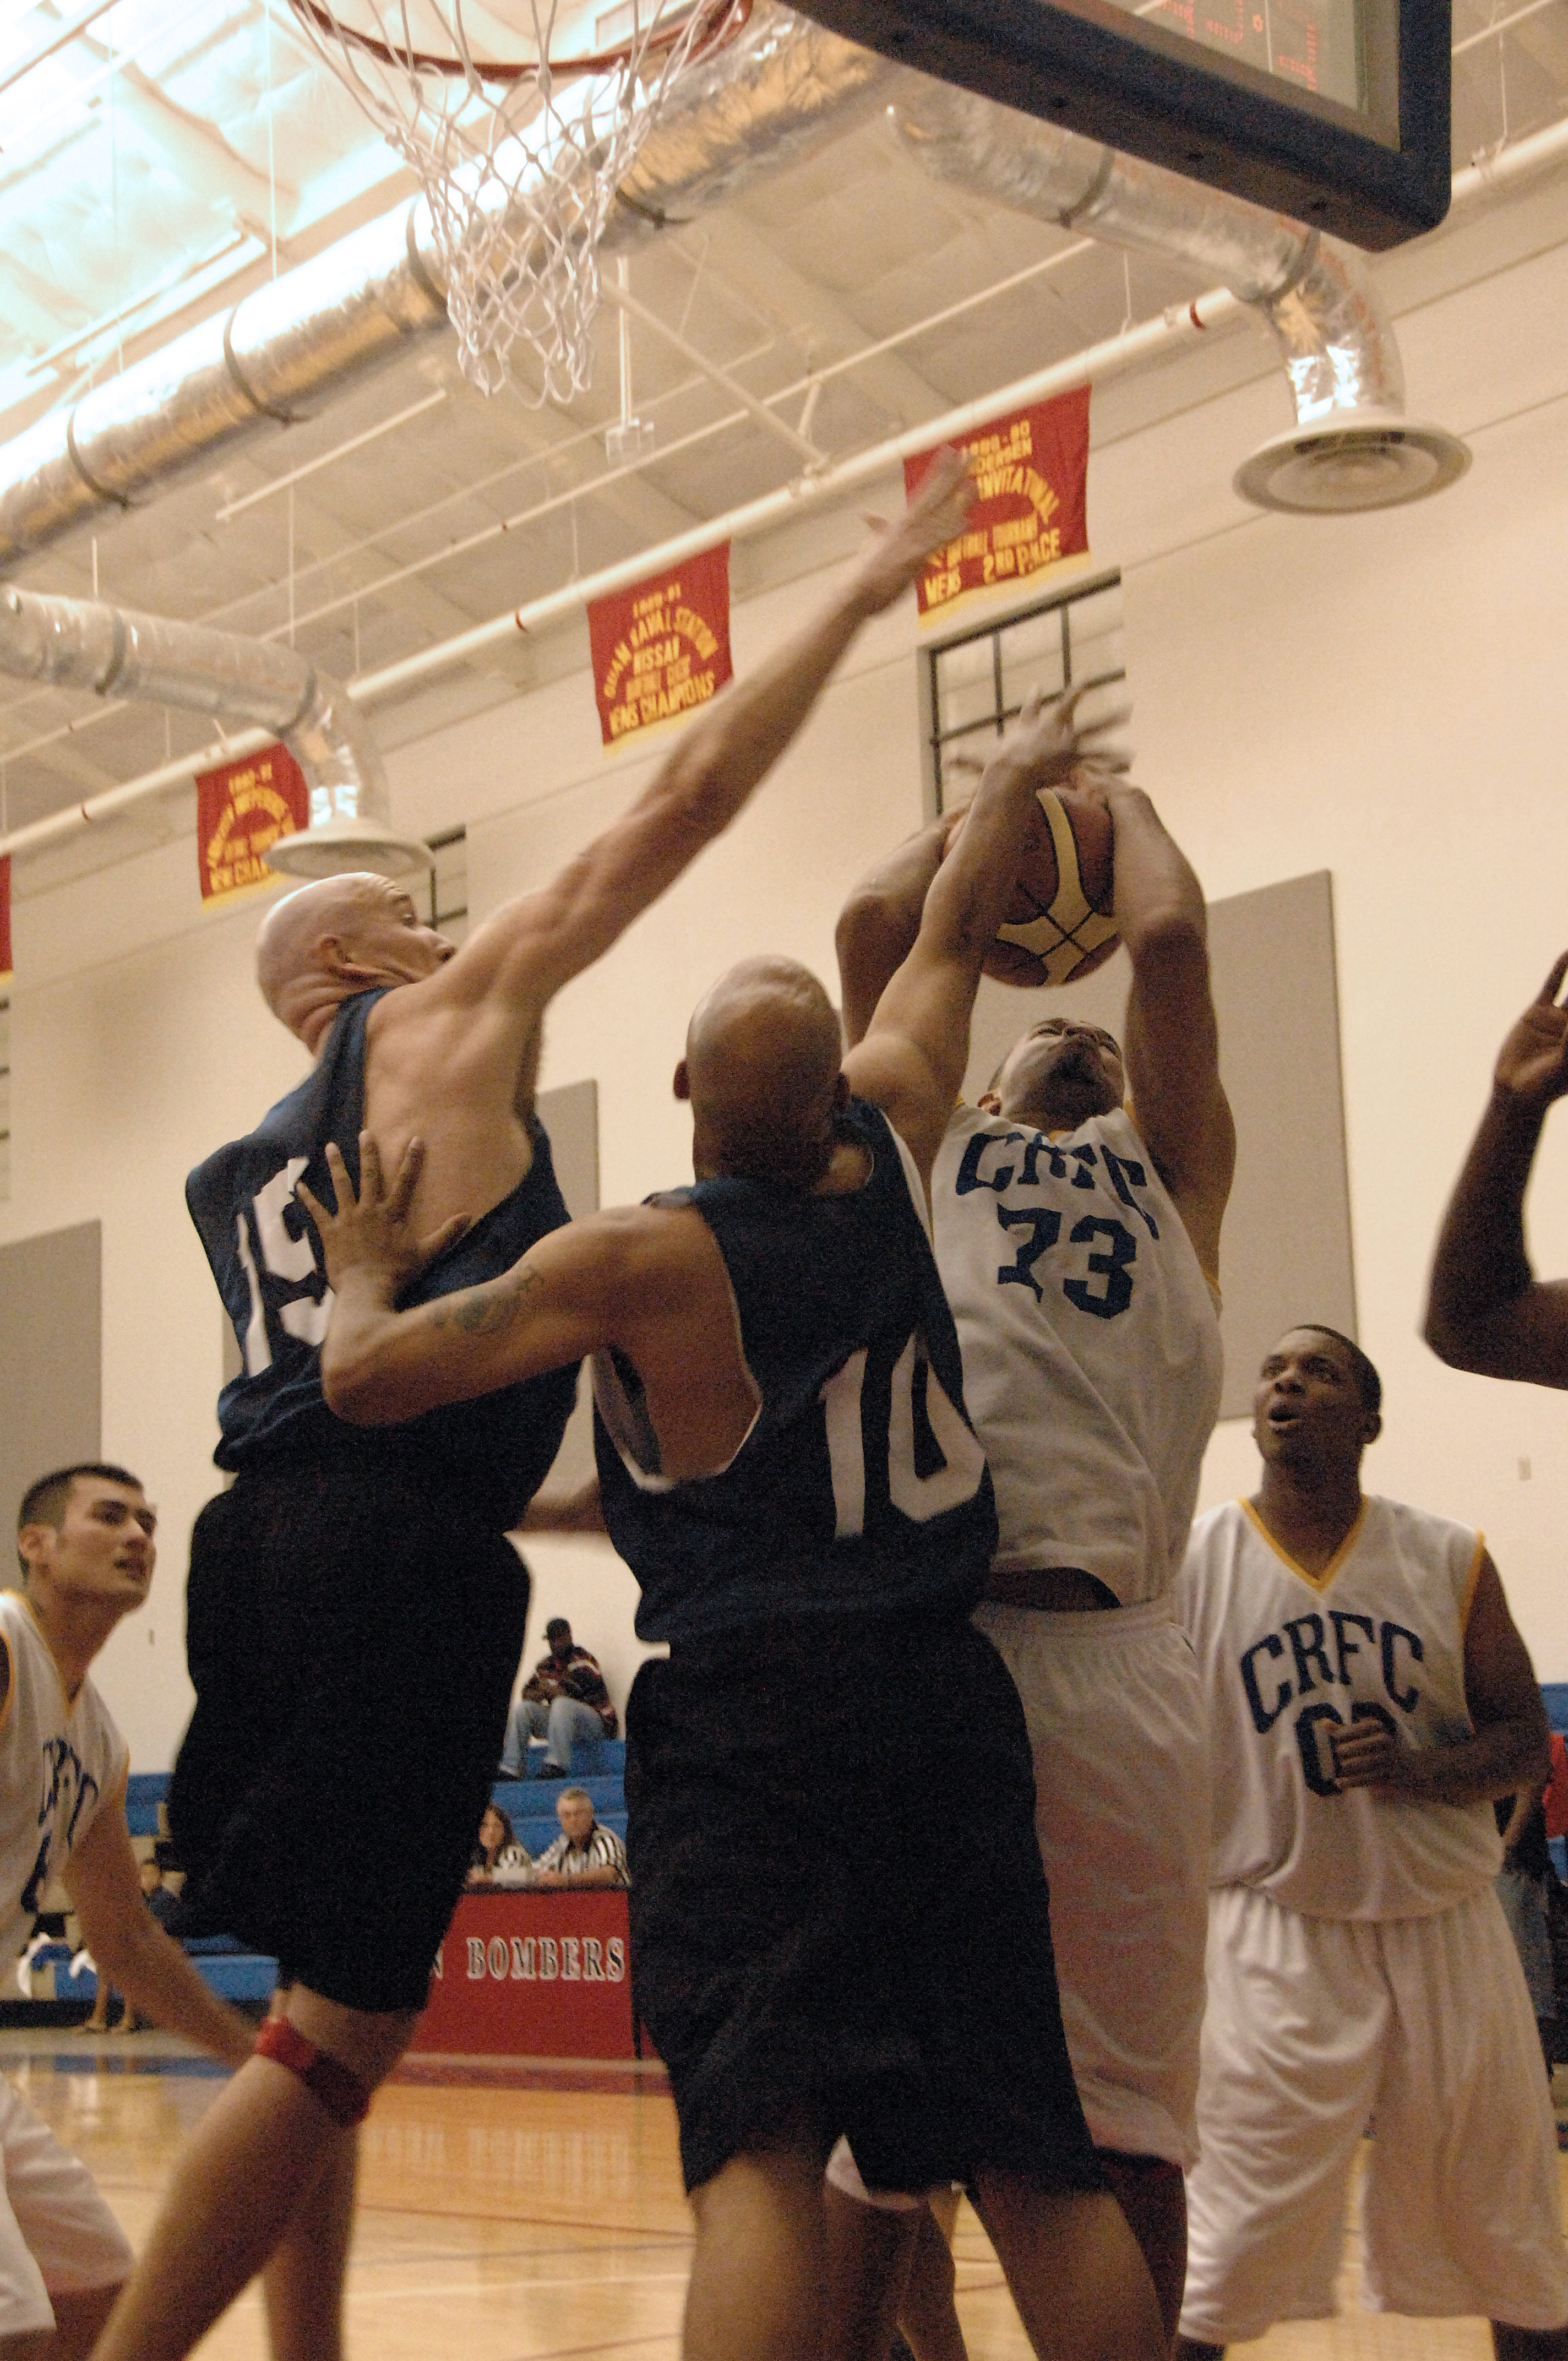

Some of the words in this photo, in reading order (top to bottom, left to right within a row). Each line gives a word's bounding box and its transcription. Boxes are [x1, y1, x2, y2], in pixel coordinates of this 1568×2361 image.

[997, 1203, 1136, 1320] 73
[818, 1327, 986, 1539] 10
[1240, 1610, 1423, 1734] CRFC
[466, 1935, 625, 1982] BOMBERS
